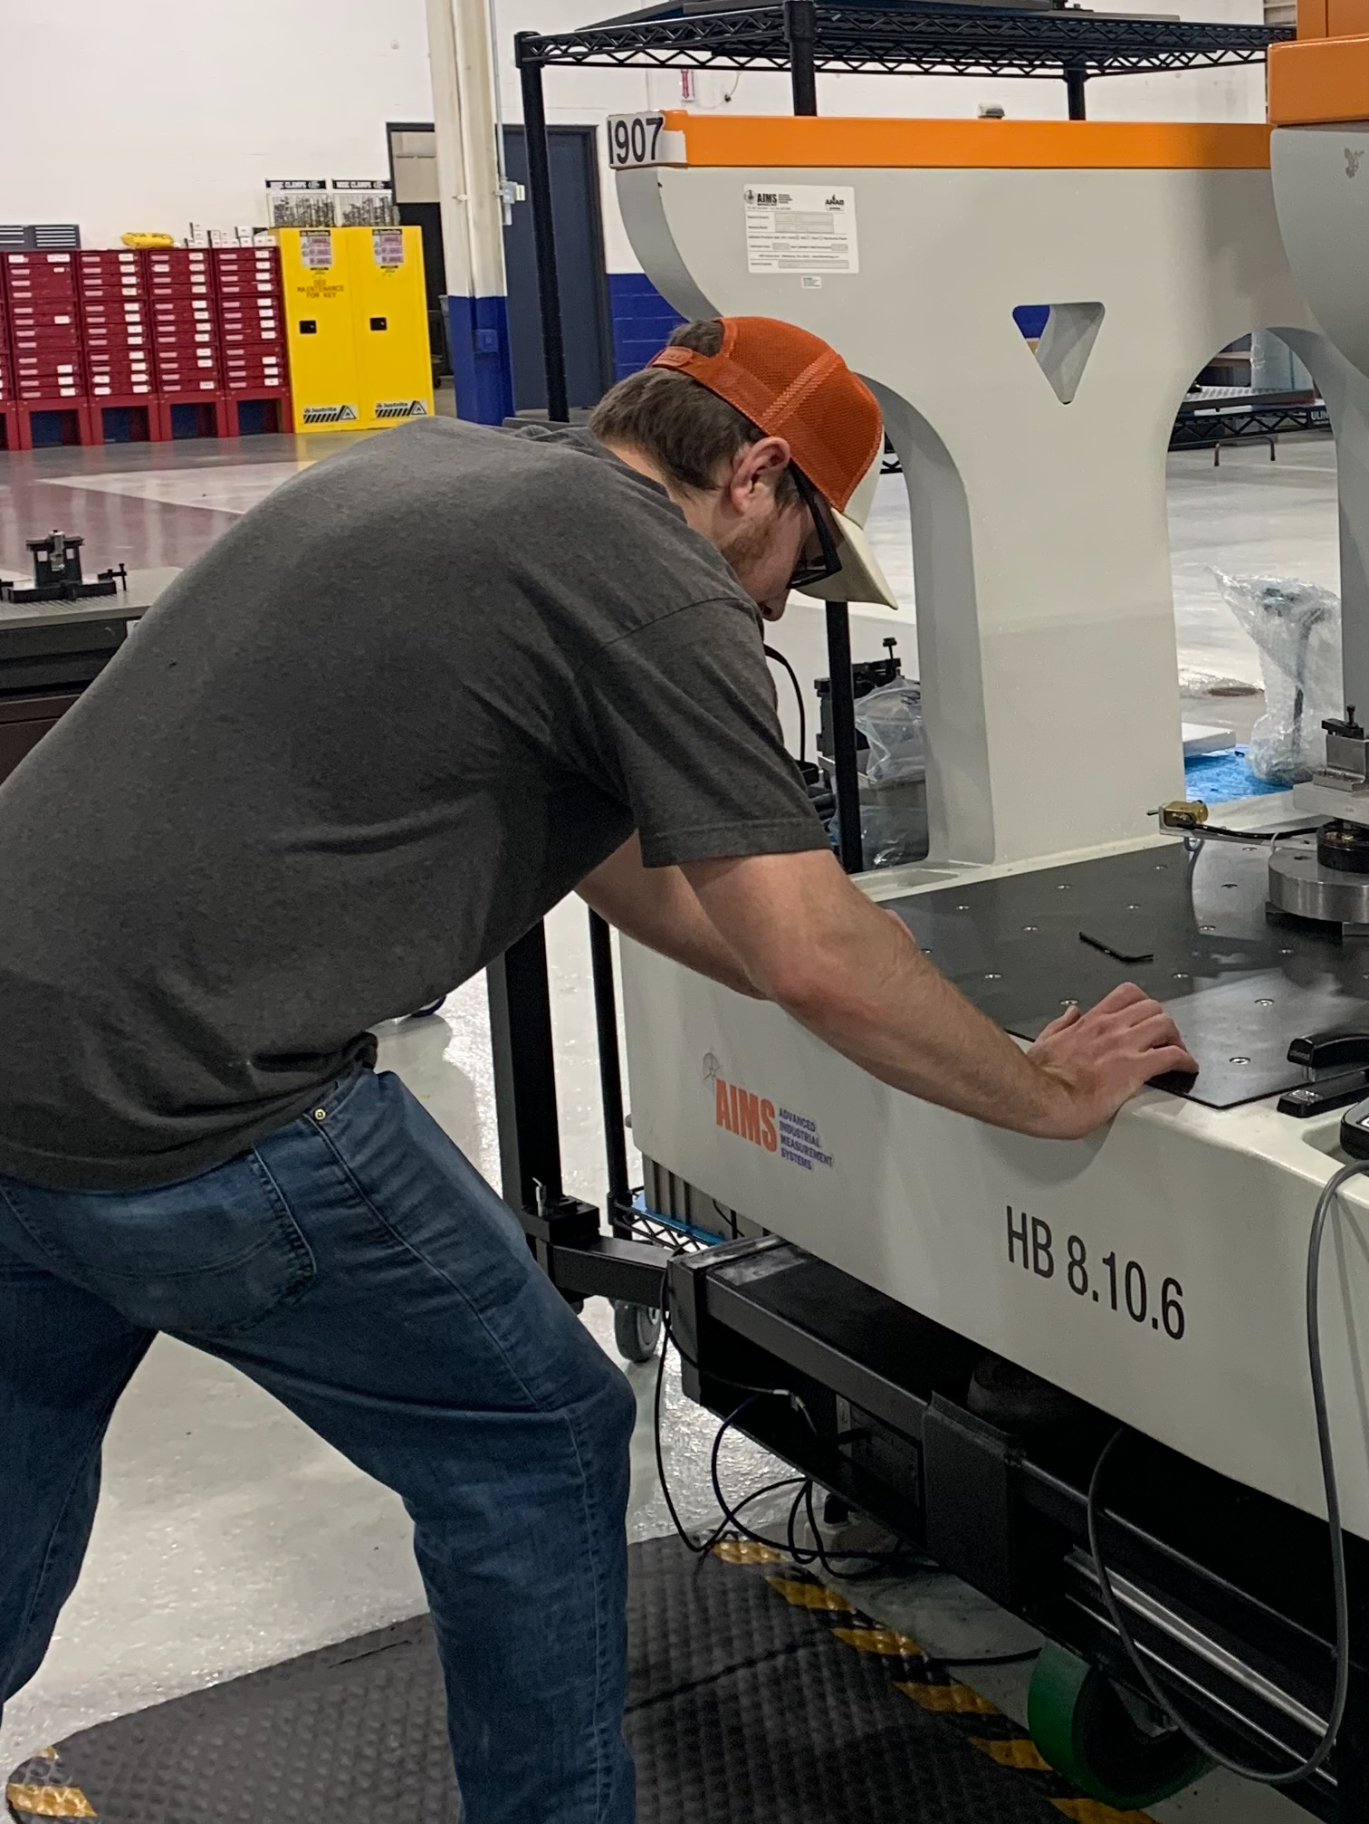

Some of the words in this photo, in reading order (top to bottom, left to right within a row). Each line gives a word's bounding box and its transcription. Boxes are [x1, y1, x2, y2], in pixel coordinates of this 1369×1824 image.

[607, 117, 664, 165] 1907
[757, 193, 778, 203] AIMS
[1311, 411, 1329, 420] ULIN
[716, 1078, 777, 1153] AIMS
[779, 1107, 815, 1132] ADVANCED
[779, 1120, 820, 1148] INDUSTRIAL
[780, 1133, 833, 1168] MEASUREMENT
[780, 1146, 812, 1171] SYSTEMS
[1006, 1205, 1054, 1279] HB
[1067, 1234, 1186, 1341] 8.10.6
